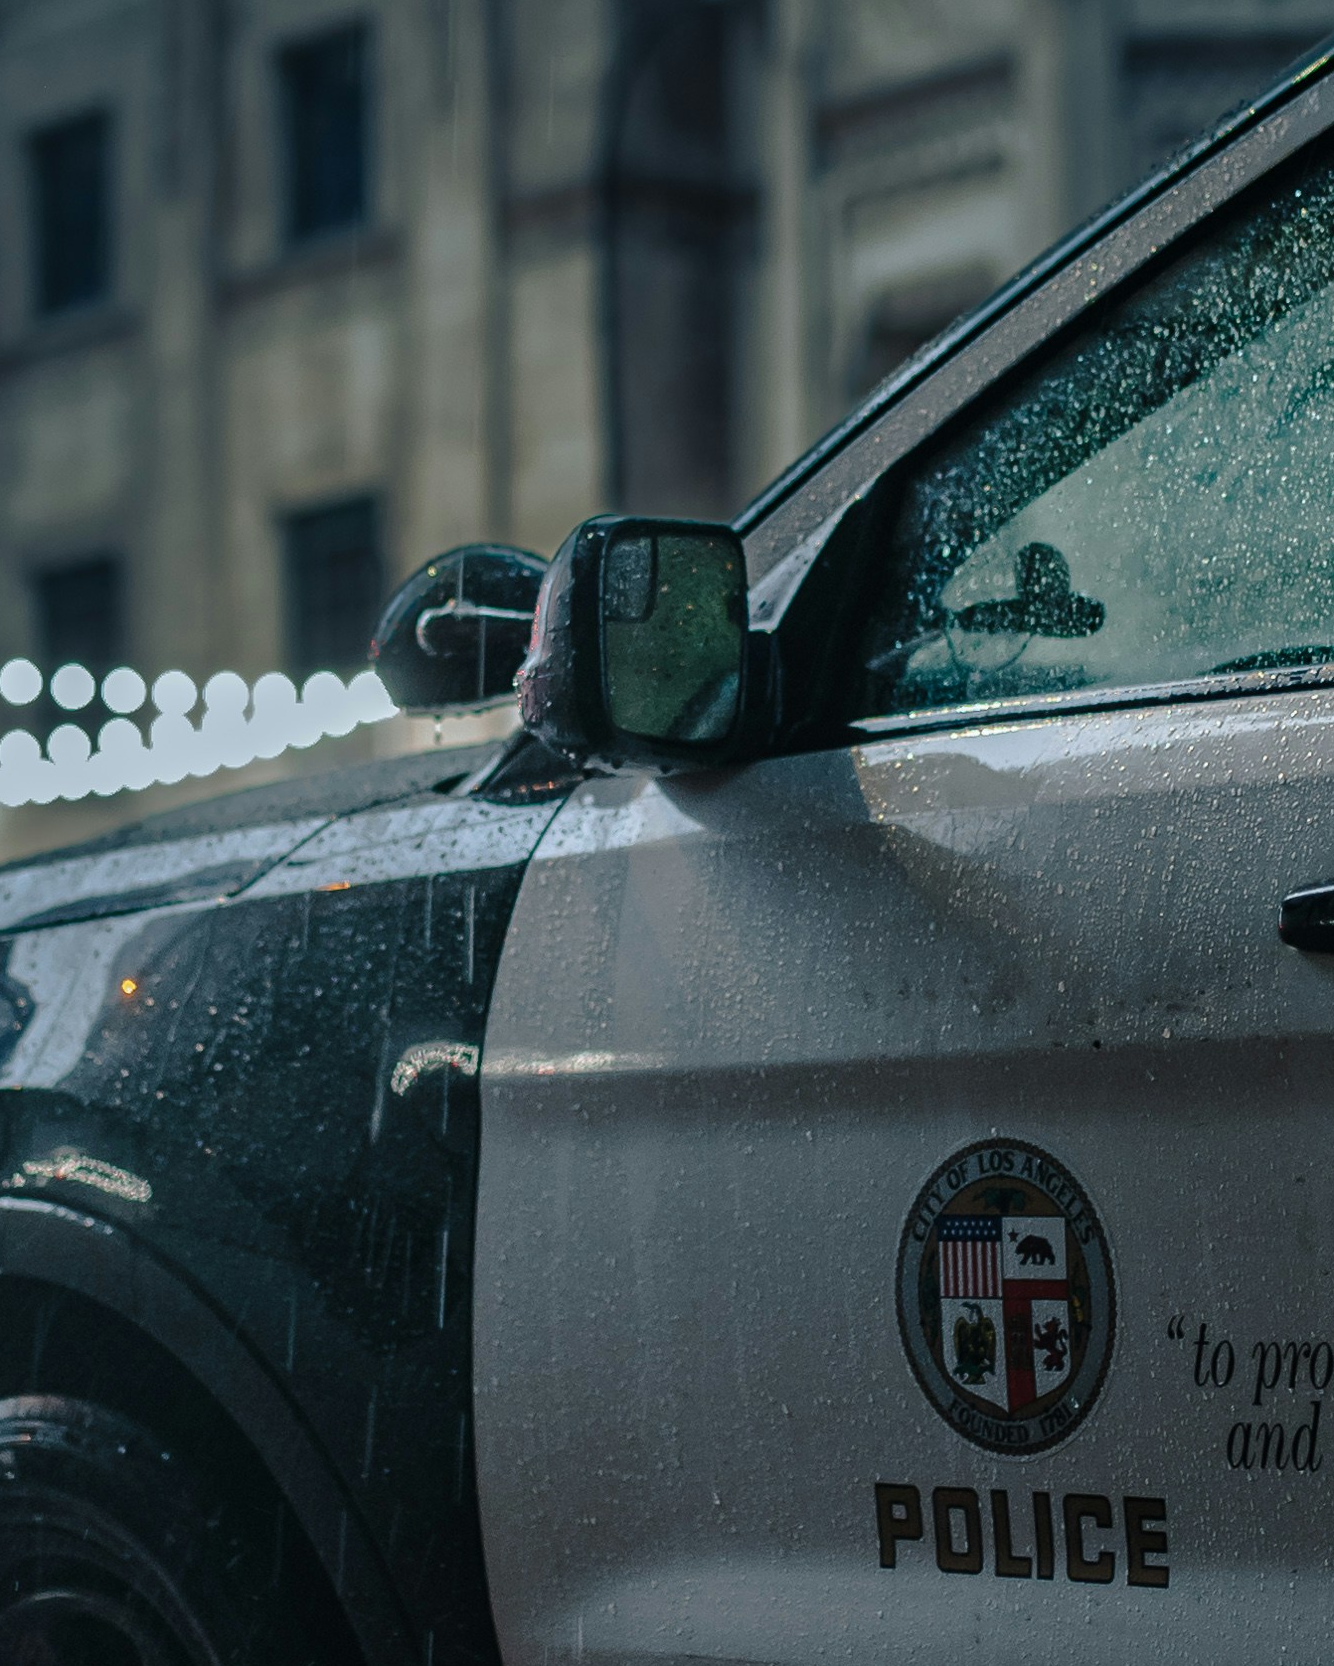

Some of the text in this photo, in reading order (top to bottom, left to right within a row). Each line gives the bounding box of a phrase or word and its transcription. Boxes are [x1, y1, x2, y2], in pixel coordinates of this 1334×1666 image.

[912, 1150, 1096, 1245] CITY OF LOS ANGELES
[948, 1398, 1074, 1444] FOUNDED 1781
[1227, 1400, 1322, 1473] and
[873, 1480, 1171, 1589] POLICE
